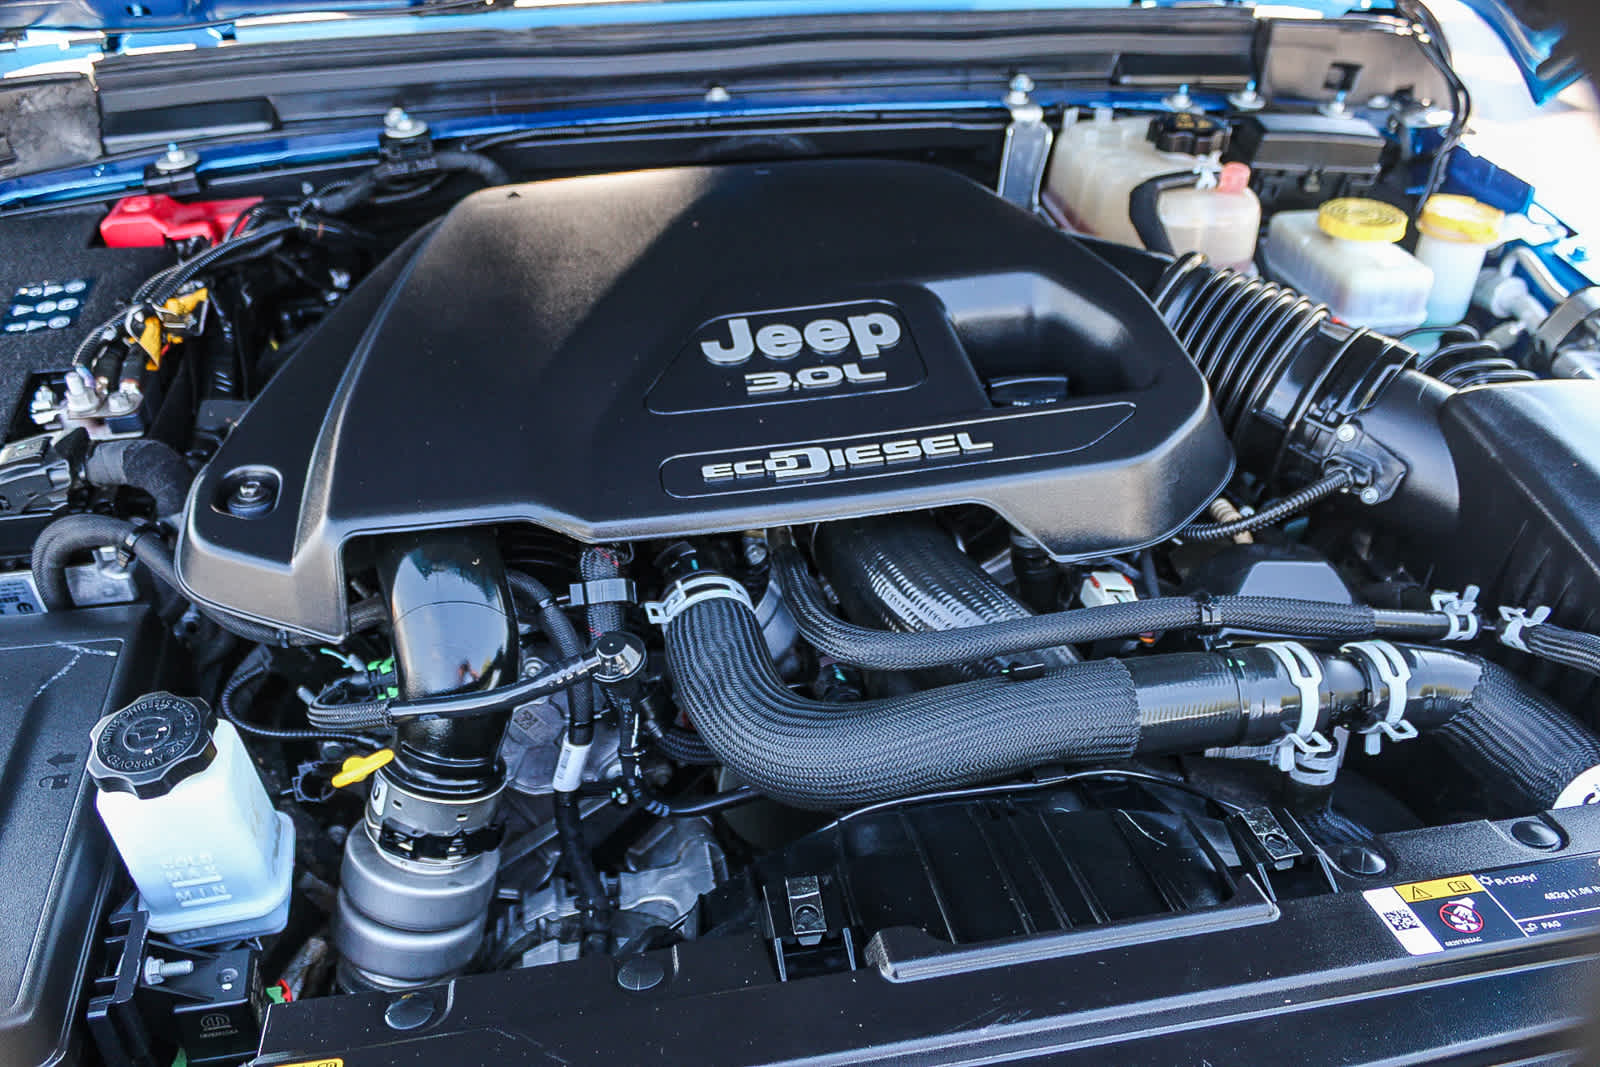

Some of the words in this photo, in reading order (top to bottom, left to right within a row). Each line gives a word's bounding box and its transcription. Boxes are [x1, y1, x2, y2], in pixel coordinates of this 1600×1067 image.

[700, 312, 901, 365] Jeep
[744, 363, 887, 395] 3.0L
[106, 753, 165, 770] APPROVED
[175, 884, 229, 903] MIN
